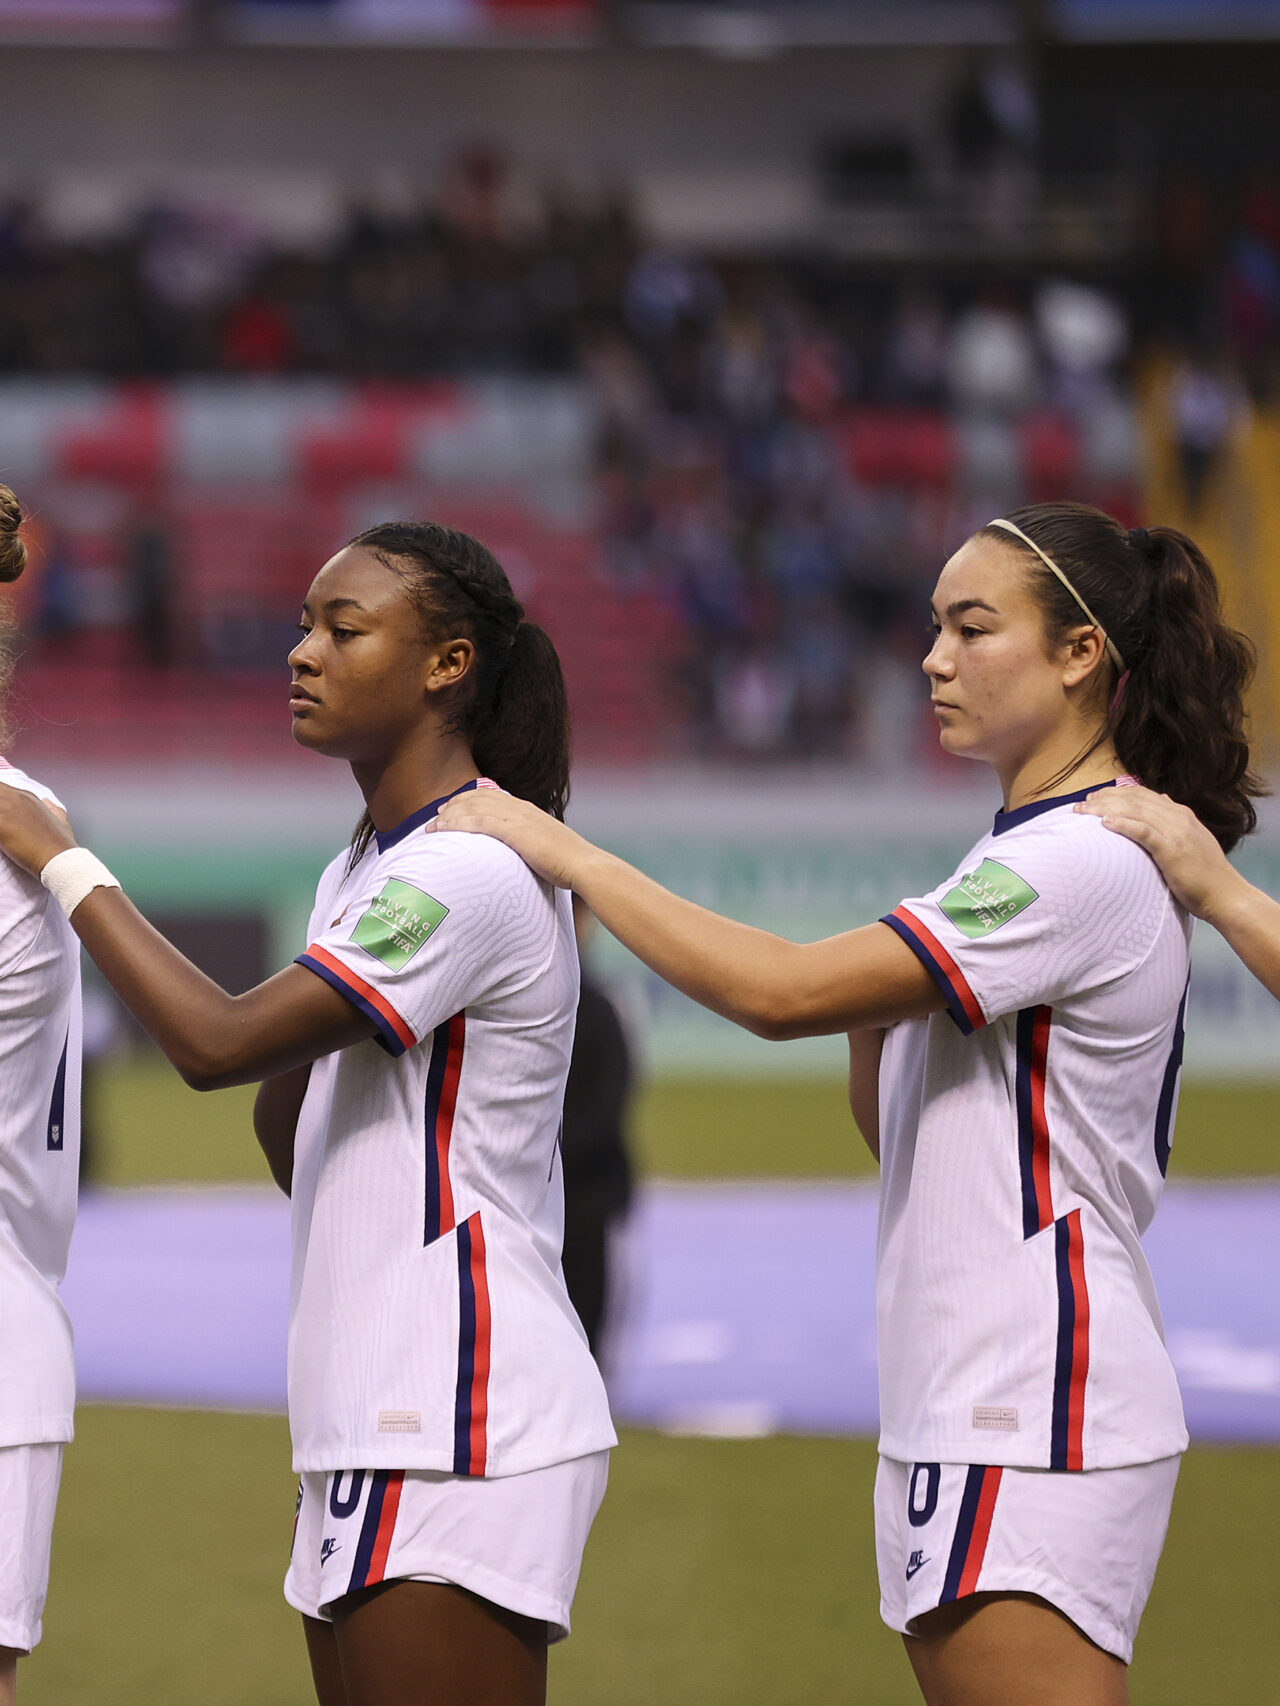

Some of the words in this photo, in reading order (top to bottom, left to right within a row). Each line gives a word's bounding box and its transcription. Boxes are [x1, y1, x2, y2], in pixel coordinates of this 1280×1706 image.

[963, 879, 1008, 917] FOOTBALL
[969, 872, 1017, 912] LIVING
[374, 903, 424, 939] FOOTBALL
[377, 895, 431, 931] LIVING
[970, 904, 993, 929] FIFA
[387, 931, 411, 954] FIFA
